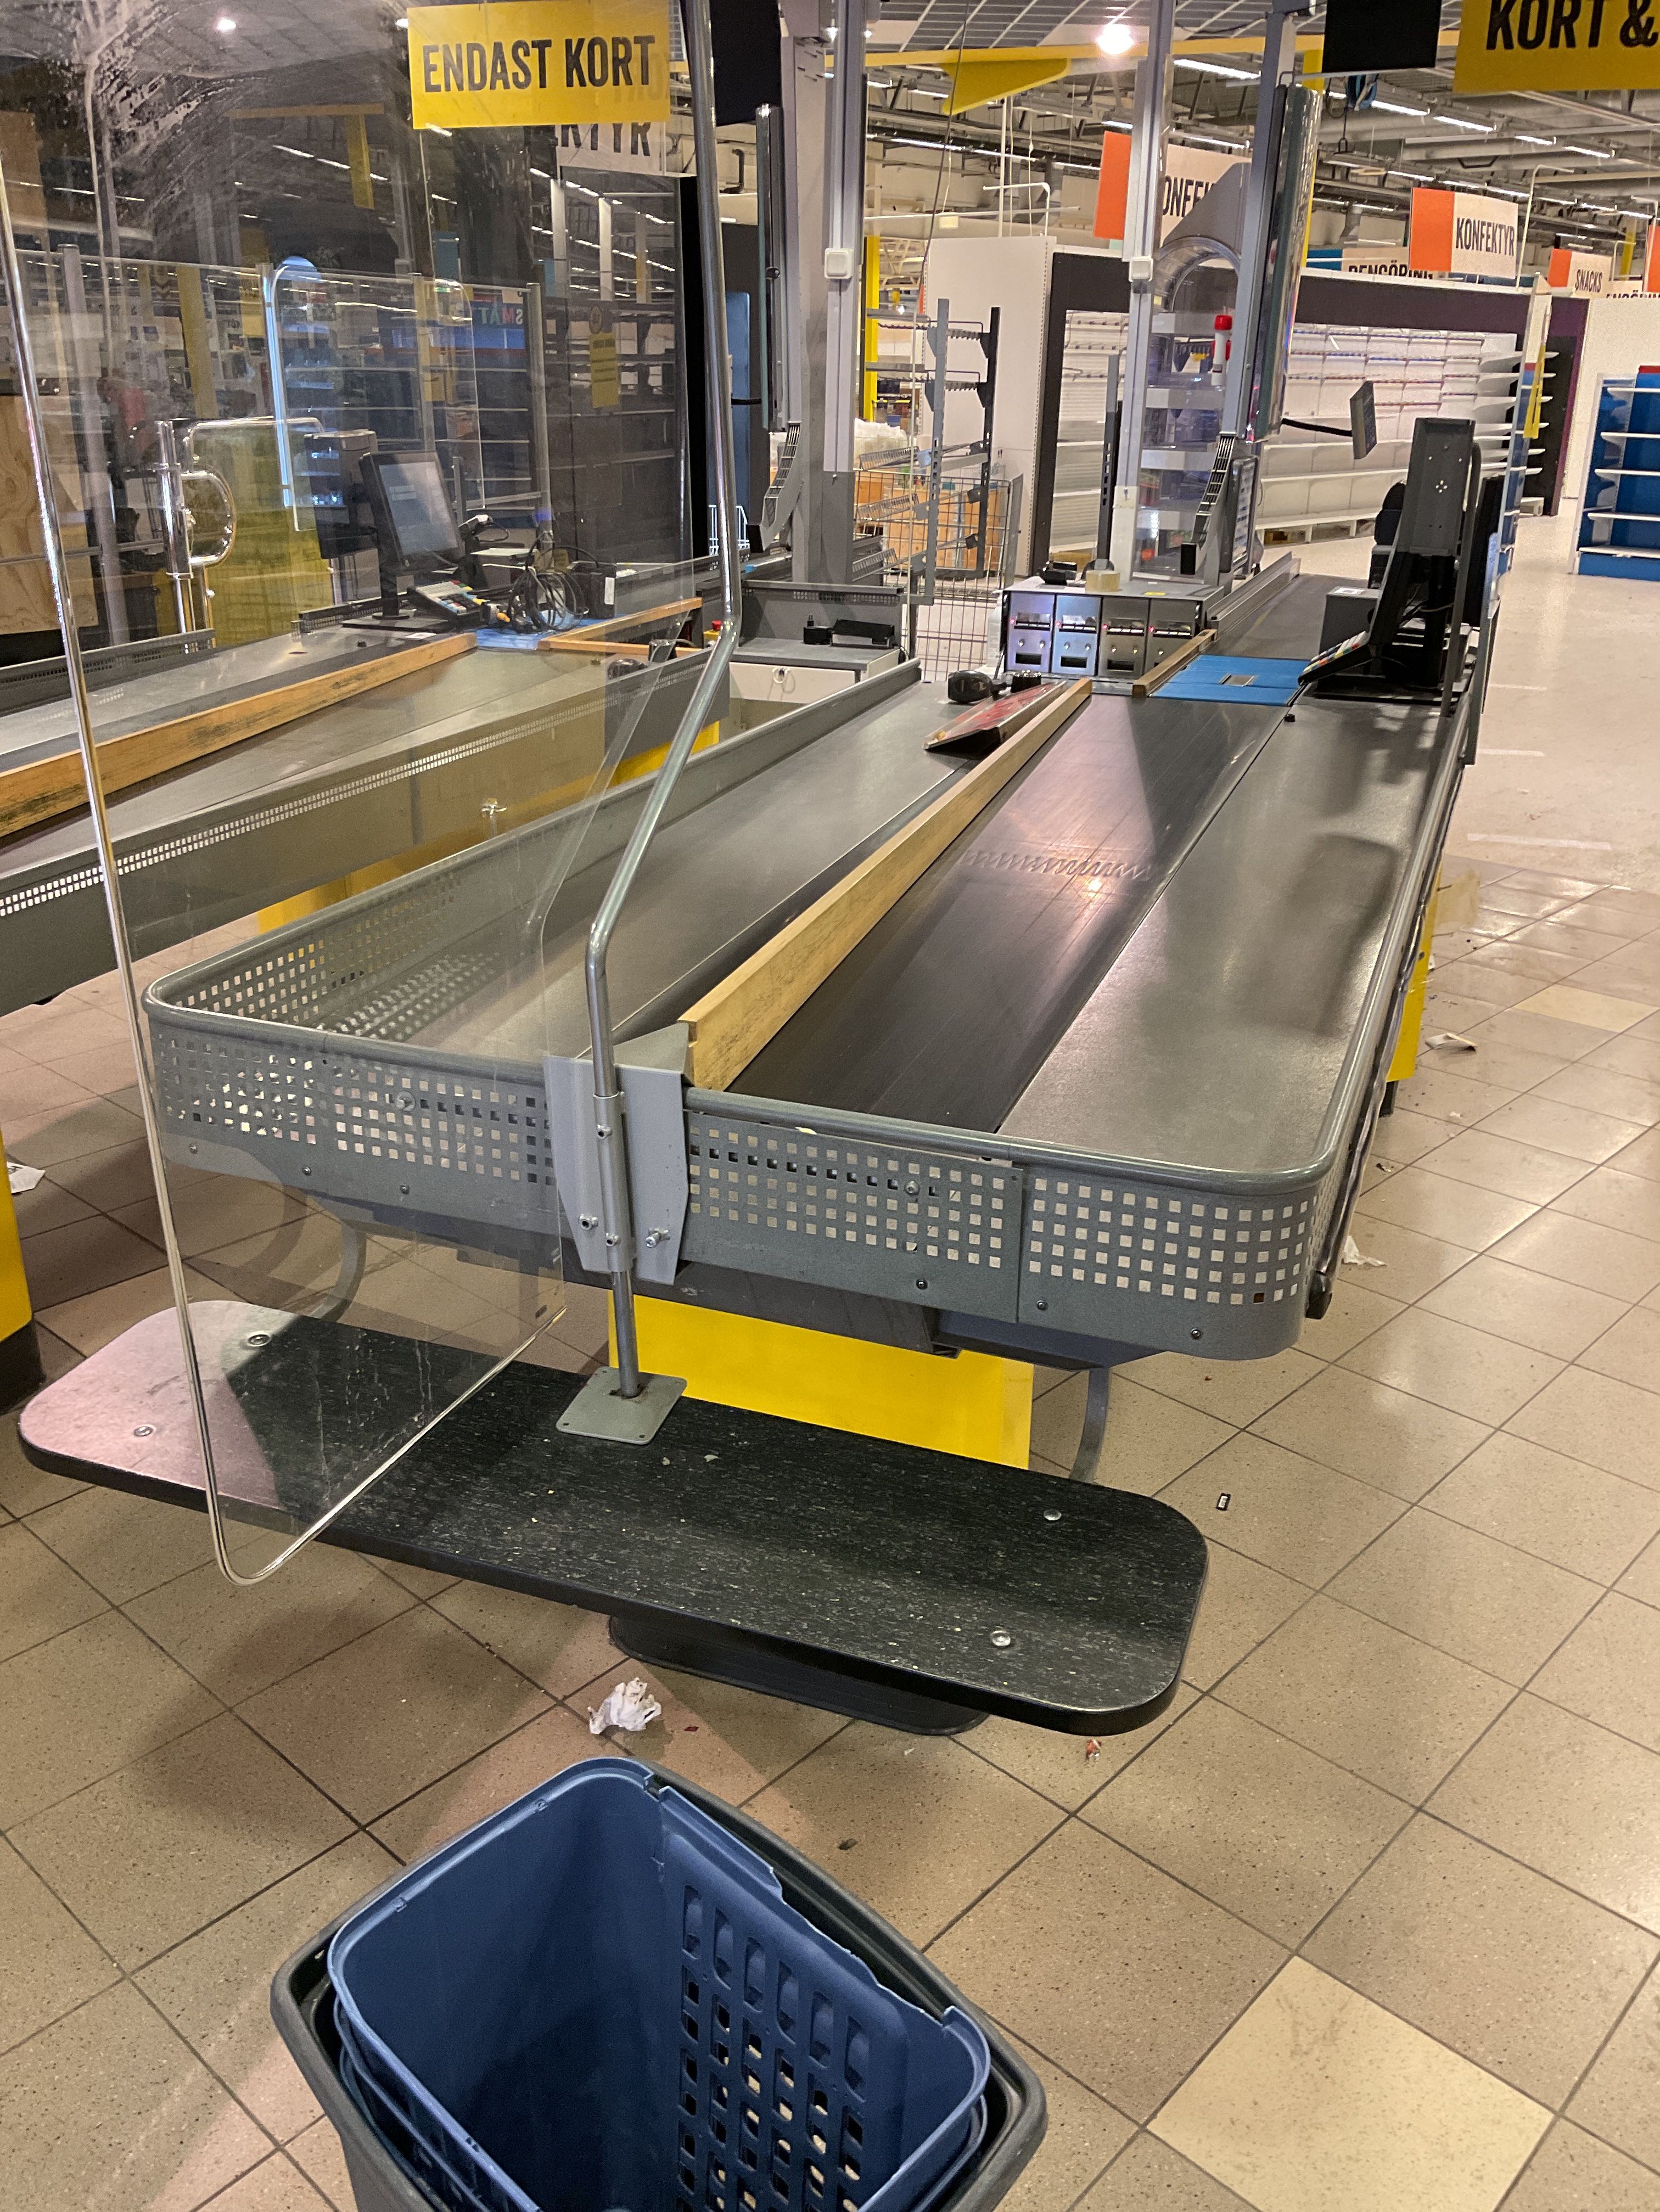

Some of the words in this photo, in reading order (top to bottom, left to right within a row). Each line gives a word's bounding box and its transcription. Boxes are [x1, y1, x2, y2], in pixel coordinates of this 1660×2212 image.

[1486, 0, 1605, 50] KORT
[423, 39, 552, 93] ENDAST
[565, 35, 655, 88] KORT
[1456, 217, 1515, 256] KONFEKTYR
[1575, 268, 1603, 293] SNACKS
